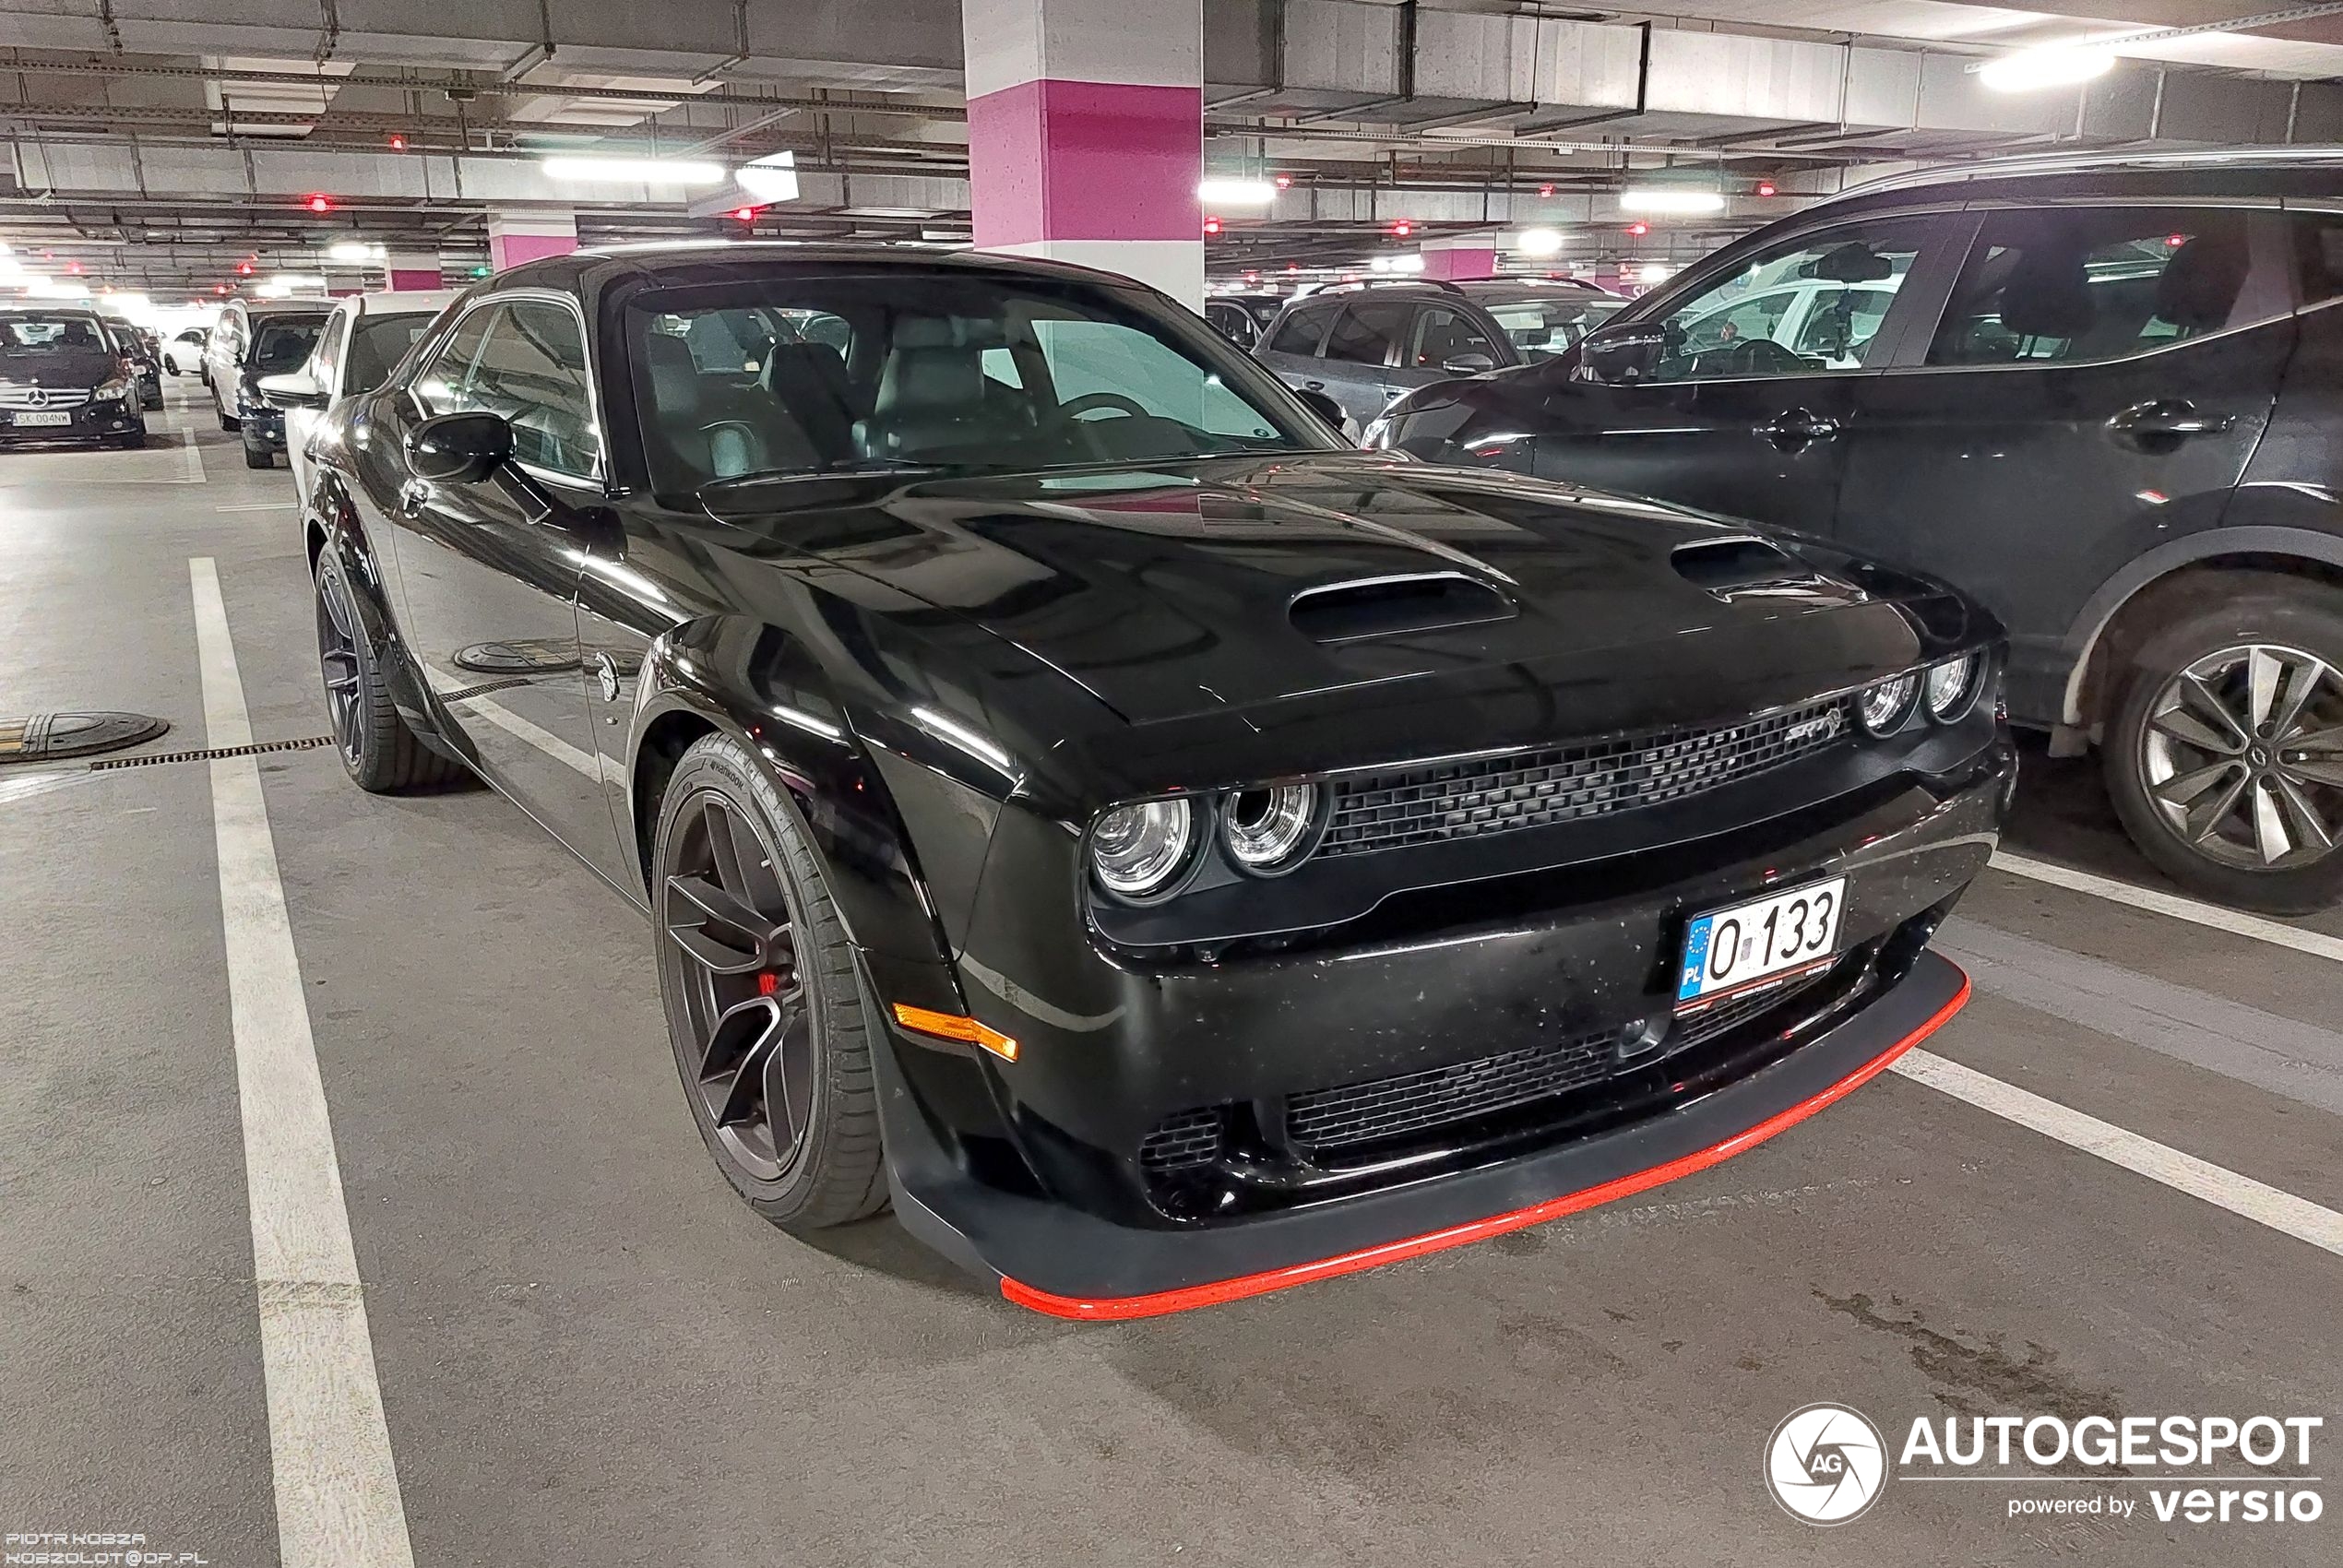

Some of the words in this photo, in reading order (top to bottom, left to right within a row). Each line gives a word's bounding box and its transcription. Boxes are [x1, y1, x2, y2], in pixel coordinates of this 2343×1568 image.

[19, 414, 31, 423] SK
[1763, 891, 1834, 967] 133
[1682, 966, 1702, 986] PL
